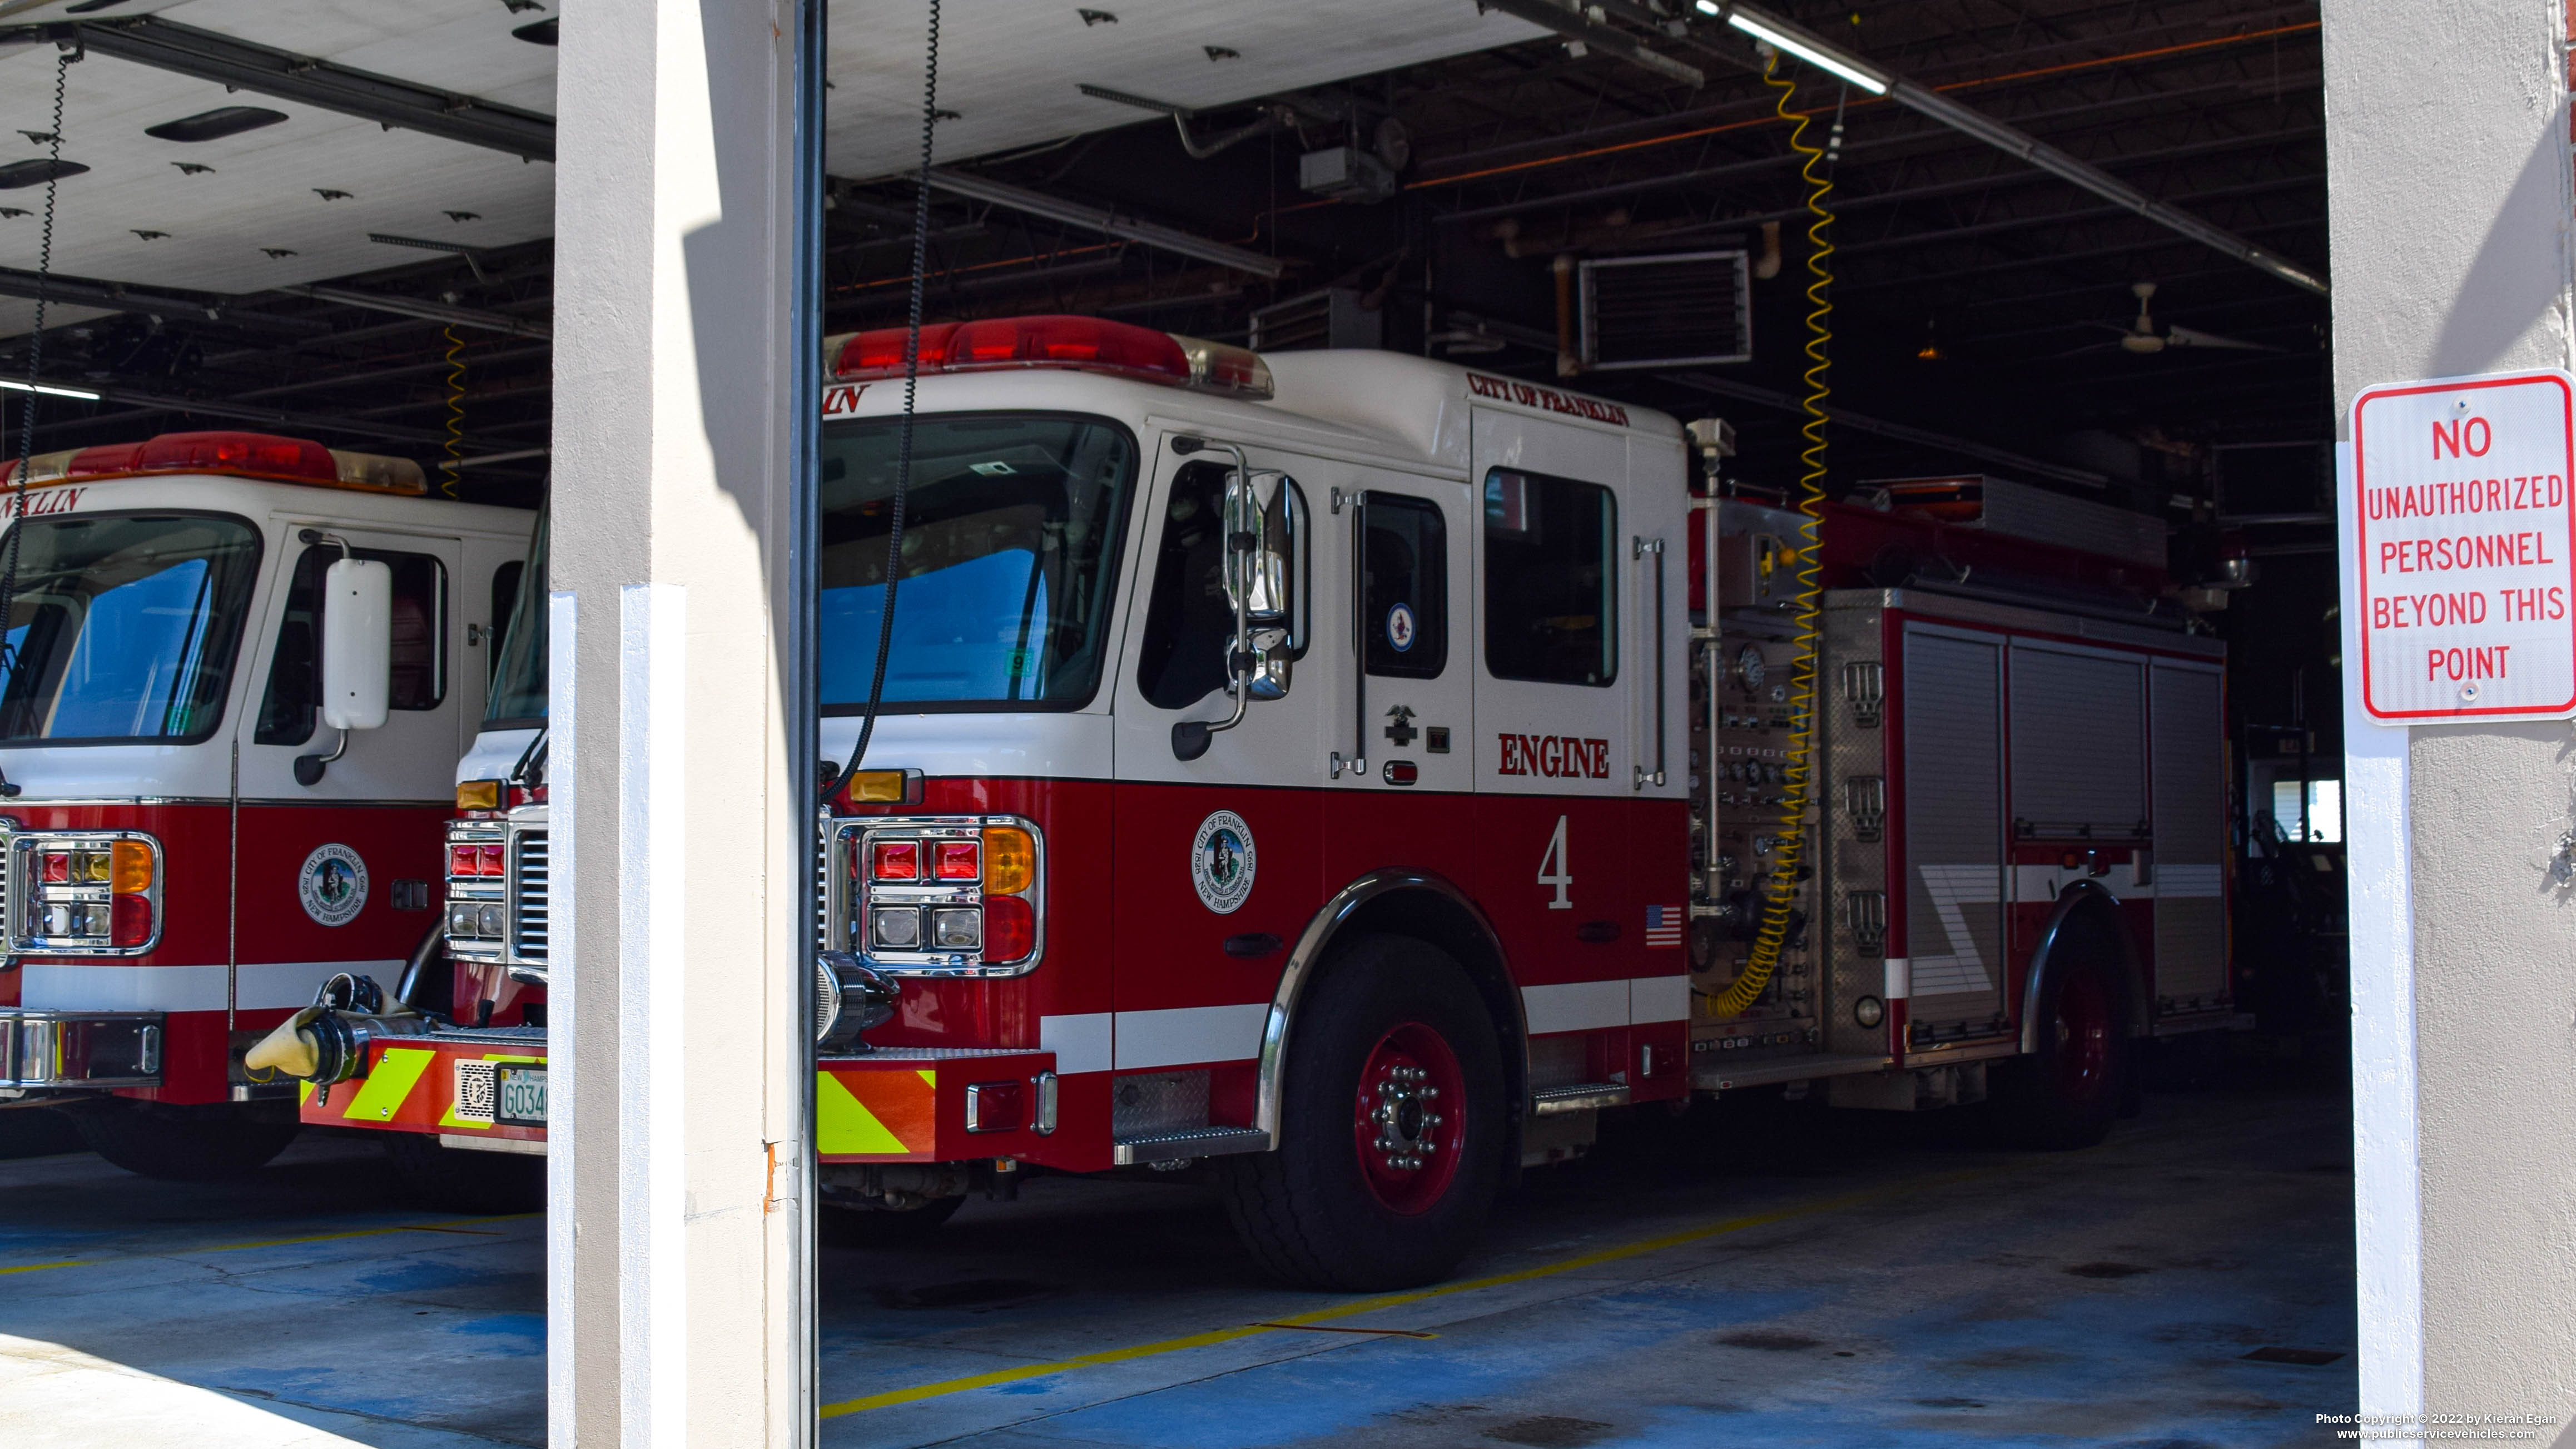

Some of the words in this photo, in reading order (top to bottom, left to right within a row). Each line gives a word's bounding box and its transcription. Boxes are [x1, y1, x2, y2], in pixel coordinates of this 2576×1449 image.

[1466, 372, 1512, 401] CITY
[1513, 383, 1537, 406] OF
[1538, 389, 1630, 428] FRANKLIN
[2433, 416, 2491, 460] NO
[2369, 474, 2563, 520] UNAUTHORIZED
[2381, 532, 2553, 574] PERSONNEL
[2374, 592, 2486, 629] BEYOND
[2500, 587, 2564, 622] THIS
[2429, 646, 2510, 681] POINT
[1498, 733, 1609, 778] ENGINE
[1197, 828, 1208, 849] CITY
[1208, 818, 1216, 830] OF
[1218, 815, 1251, 848] FRANKLIN
[305, 857, 317, 874] CITY
[316, 850, 326, 860] OF
[327, 847, 363, 874] FRANKLIN
[1538, 815, 1572, 909] 4
[306, 900, 321, 916] NEW
[322, 897, 363, 922] HAMPSHIRE
[1198, 881, 1213, 901] NEW
[1214, 877, 1250, 909] HAMPSHIRE
[505, 1084, 548, 1116] G034
